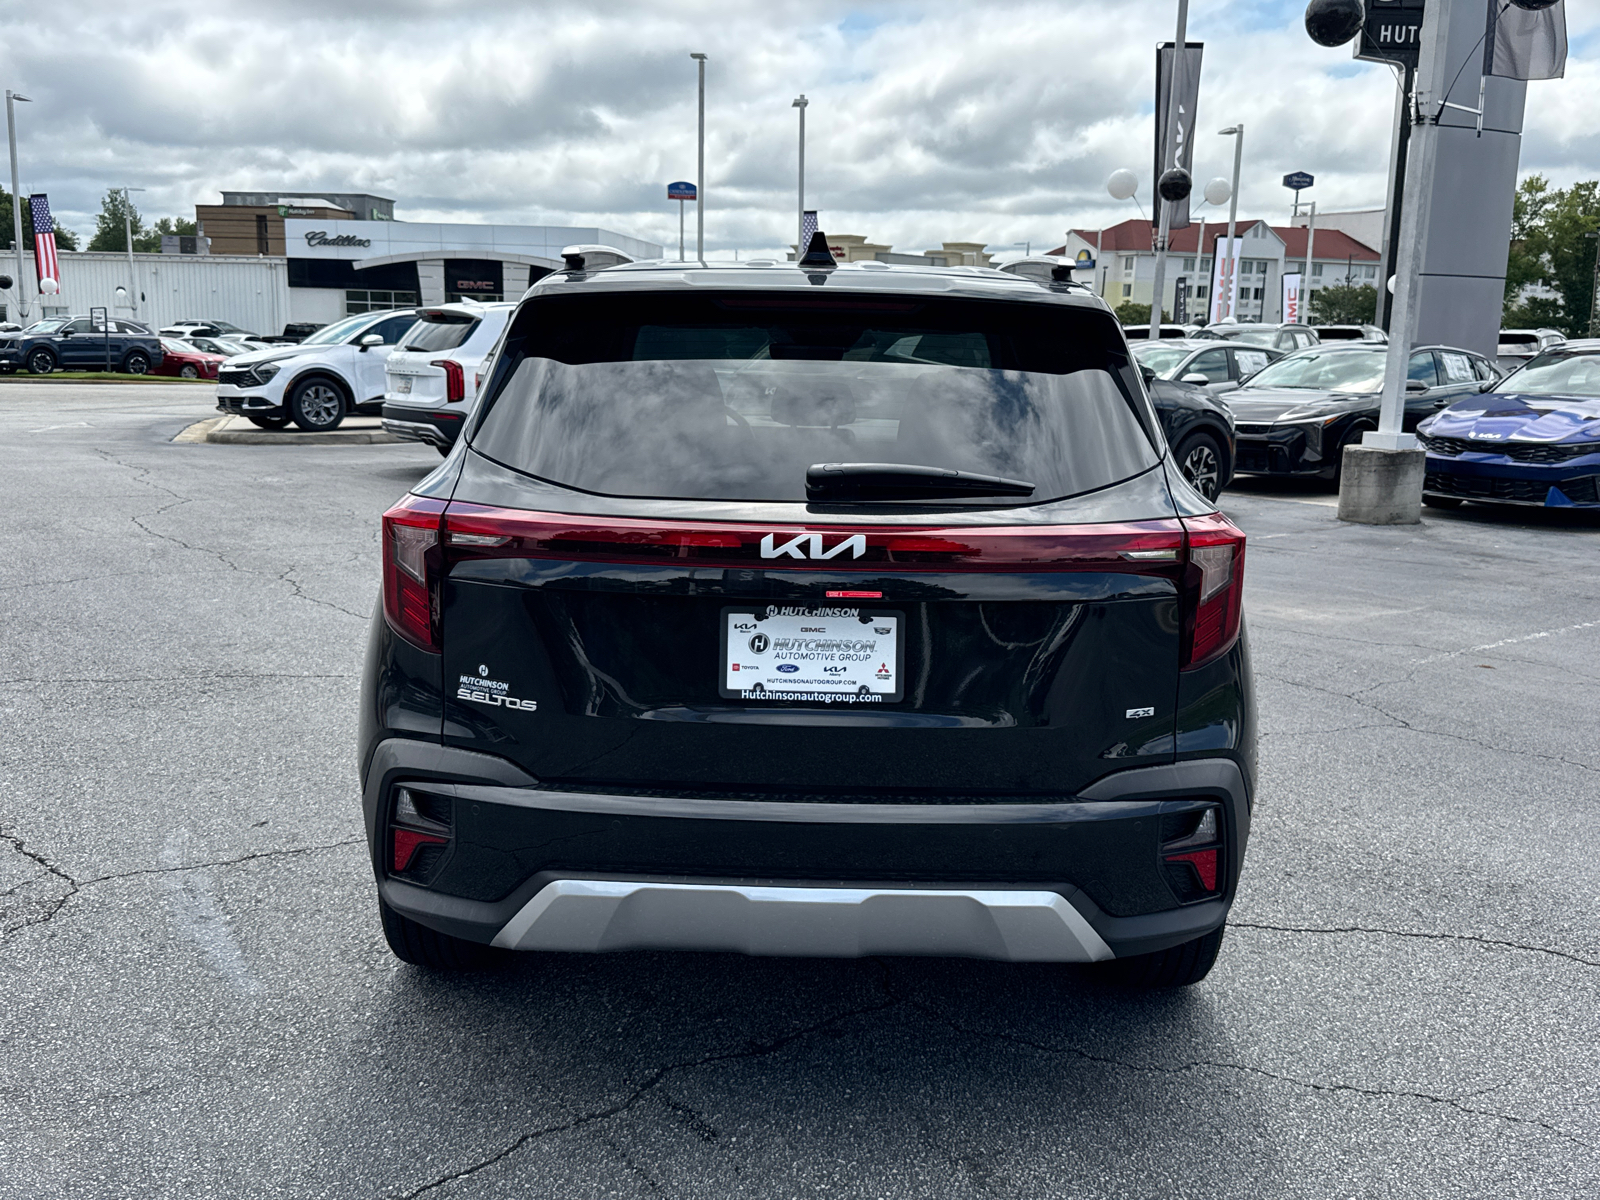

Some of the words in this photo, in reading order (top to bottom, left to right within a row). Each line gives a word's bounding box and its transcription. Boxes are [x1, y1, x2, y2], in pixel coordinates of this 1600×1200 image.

[1380, 25, 1422, 43] HUT
[305, 231, 371, 248] Cadillac
[457, 280, 494, 290] GMC
[760, 532, 867, 560] KIA
[780, 606, 860, 618] HUTCHINSON
[773, 638, 876, 653] HUTCHINSON
[774, 652, 836, 661] AUTOMOTIVE
[839, 654, 872, 662] GROUP
[460, 675, 508, 690] HUTCHINSON
[460, 683, 490, 693] AUTOMOTIVE
[766, 678, 857, 686] HUTCHINSONAUTOGROUP.COM
[457, 688, 537, 711] SELTOS
[741, 689, 882, 704] Hutchinsonautogroup.com
